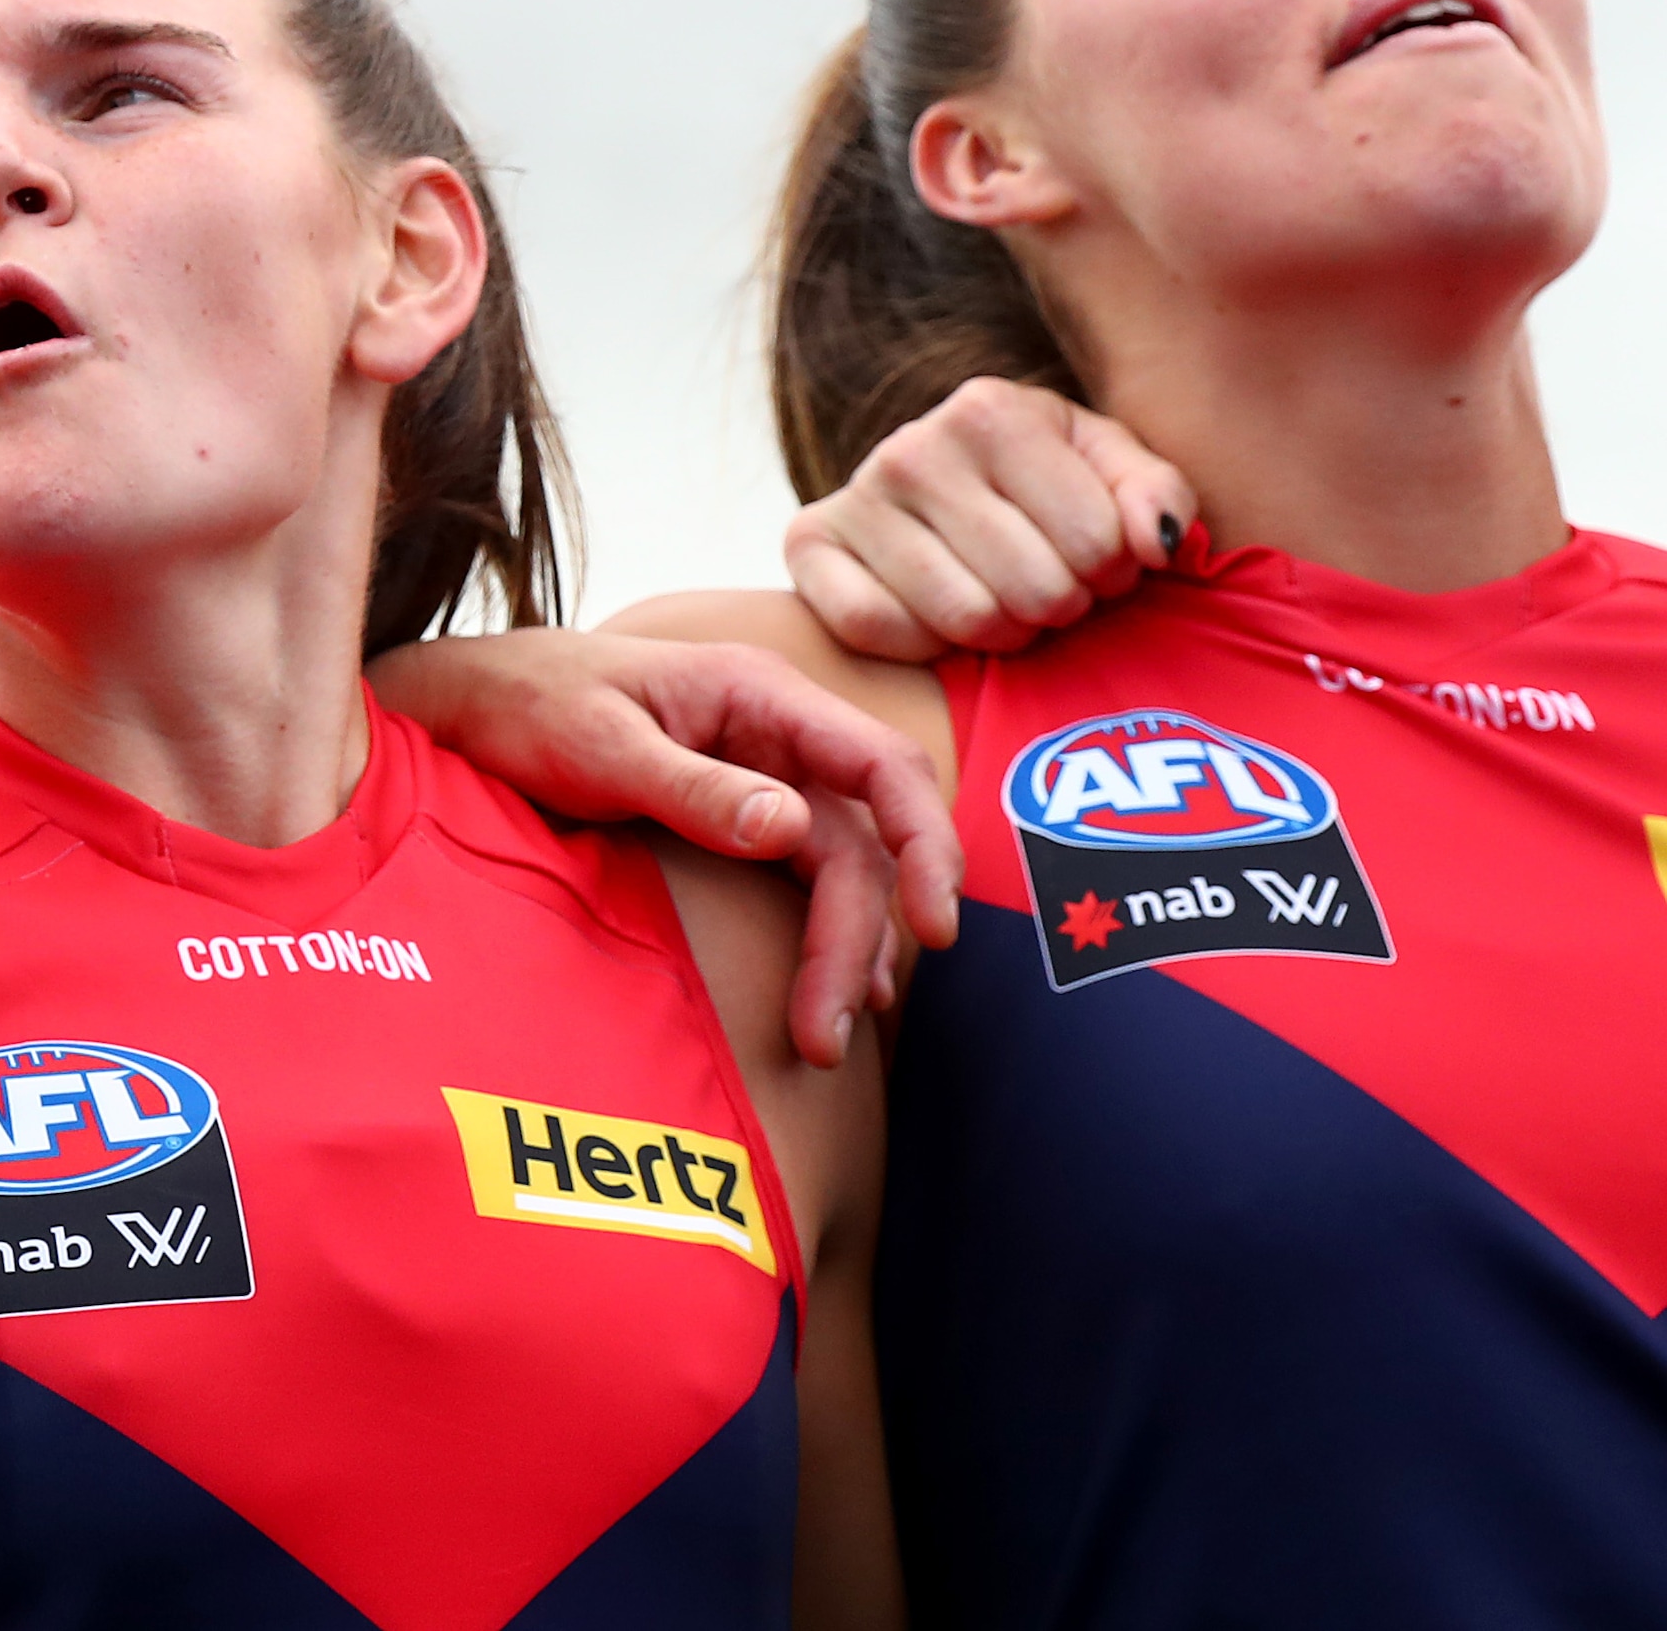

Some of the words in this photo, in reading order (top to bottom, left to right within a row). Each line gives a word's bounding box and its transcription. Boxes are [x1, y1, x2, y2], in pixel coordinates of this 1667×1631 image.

[1041, 739, 1313, 826] AFL
[1124, 875, 1236, 926] nab
[176, 928, 433, 984] COTTON:ON
[502, 1105, 747, 1228] Hertz
